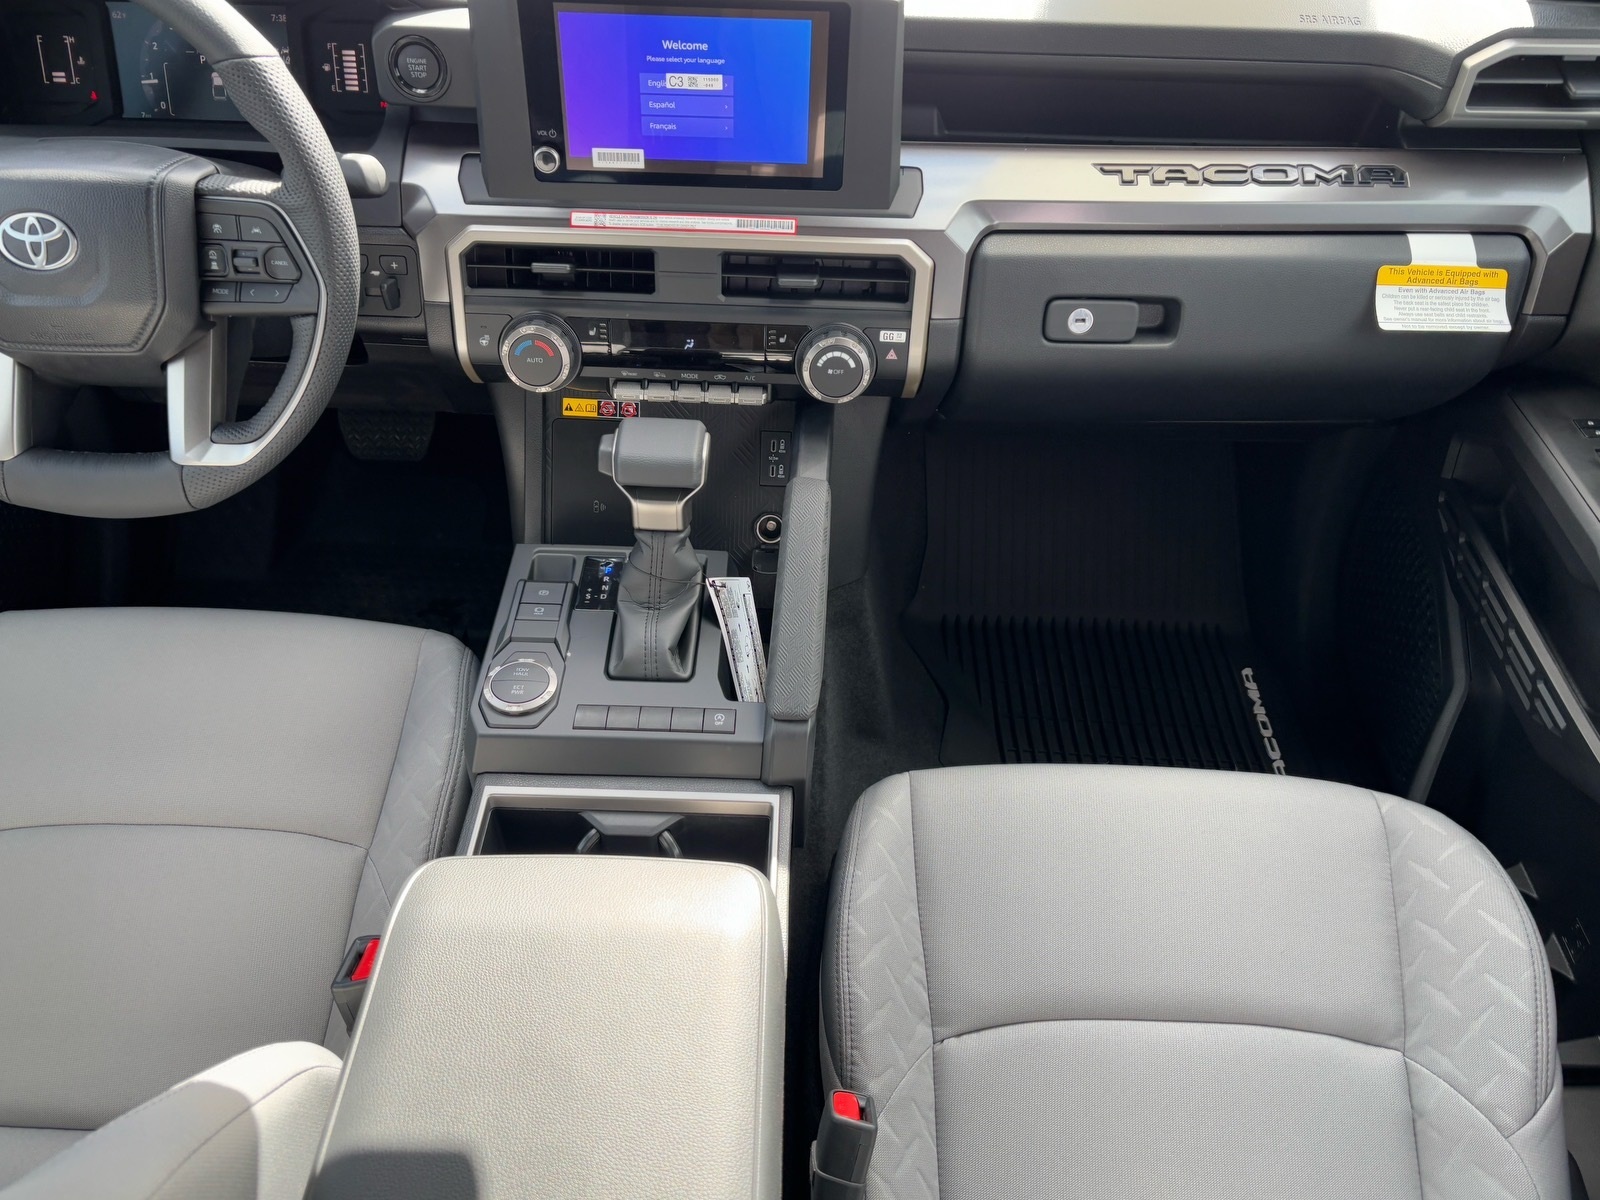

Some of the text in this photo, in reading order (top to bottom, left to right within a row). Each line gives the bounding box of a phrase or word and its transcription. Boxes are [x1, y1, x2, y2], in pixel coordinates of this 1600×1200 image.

[1300, 14, 1362, 26] SRS AIRBAG
[152, 42, 158, 50] 2
[662, 40, 708, 50] Welcome
[200, 55, 206, 64] P
[698, 57, 725, 65] language
[648, 80, 666, 88] Englis
[668, 76, 684, 88] C3
[648, 101, 676, 109] Español
[650, 122, 676, 131] Français
[1090, 162, 1410, 188] TACOMA
[1446, 270, 1481, 278] Equipped
[1406, 276, 1444, 284] Advanced
[1460, 278, 1478, 286] Bags
[883, 332, 894, 340] GG
